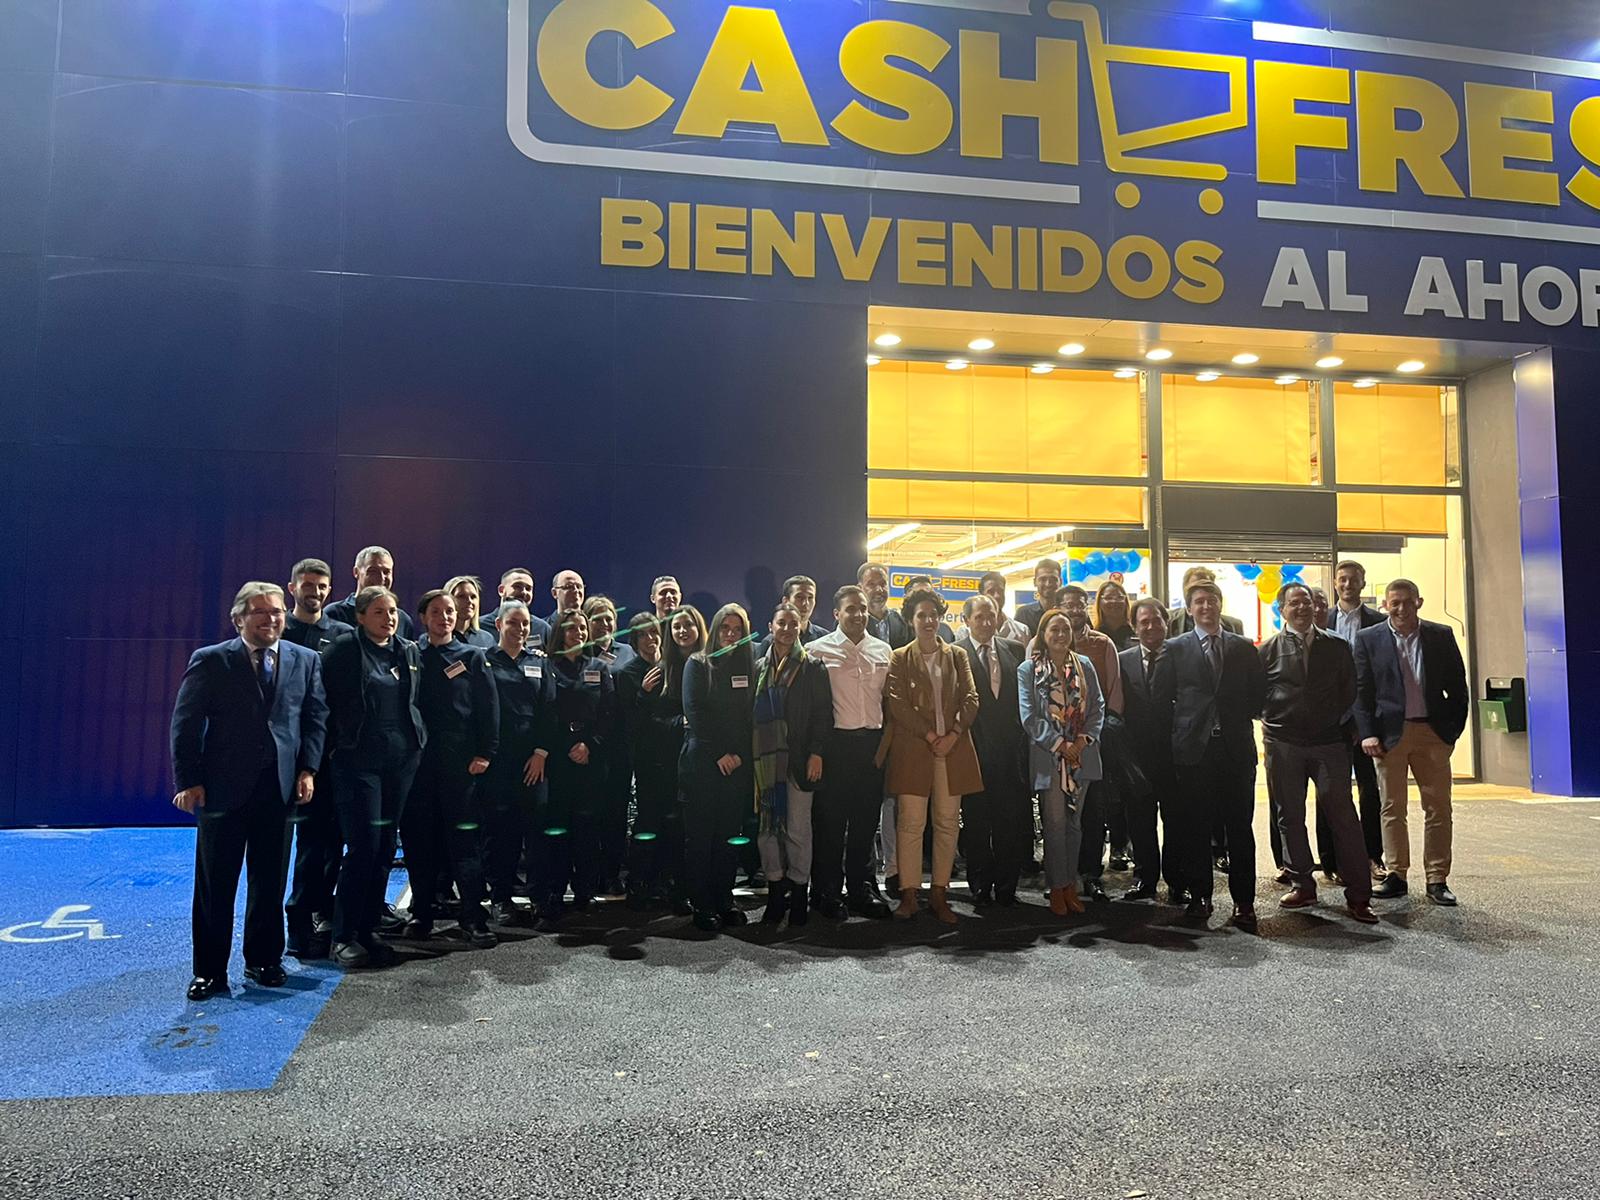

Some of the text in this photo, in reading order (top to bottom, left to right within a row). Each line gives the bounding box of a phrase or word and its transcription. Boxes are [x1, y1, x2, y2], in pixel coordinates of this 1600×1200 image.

[536, 0, 1079, 166] CASH
[600, 197, 1225, 304] BIENVENIDOS
[1262, 246, 1369, 313] AL
